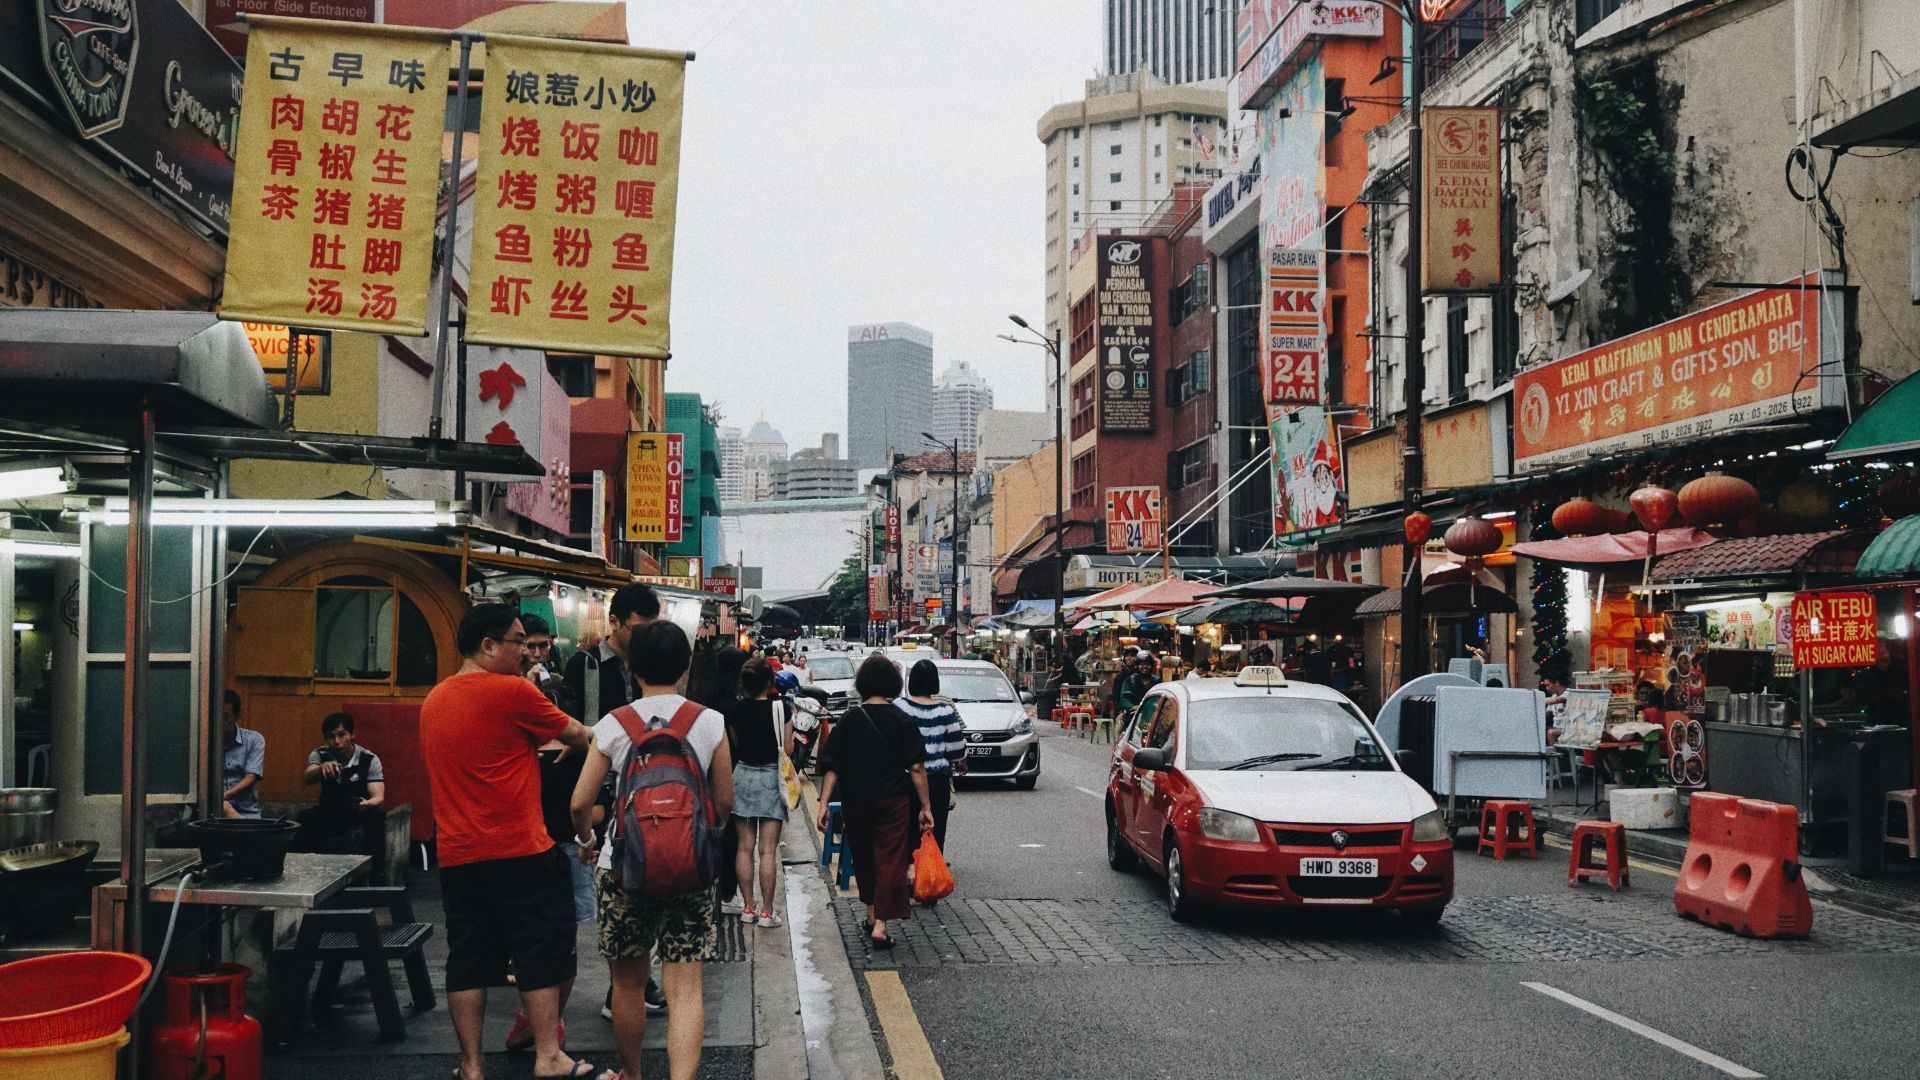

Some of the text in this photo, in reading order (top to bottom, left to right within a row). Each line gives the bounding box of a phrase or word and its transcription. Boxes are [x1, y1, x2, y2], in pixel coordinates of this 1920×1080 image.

[237, 0, 268, 11] Floor
[274, 0, 304, 13] (Side
[309, 2, 367, 18] Entrance)
[1335, 6, 1357, 18] KK
[269, 46, 427, 94] 古早味
[505, 70, 657, 114] 娘惹小炒
[261, 93, 306, 222] 肉骨茶
[1437, 159, 1448, 169] BEE
[1439, 175, 1490, 186] KEDAI
[1435, 187, 1493, 197] DAGING
[305, 98, 360, 317] 胡椒猪肚汤
[358, 103, 415, 321] 花生猪脚汤
[1440, 199, 1488, 208] SALAI
[490, 116, 541, 317] 烧烤鱼虾
[549, 119, 601, 321] 饭粥粉丝
[607, 126, 660, 326] 咖喱鱼头
[1272, 253, 1317, 266] PASAR RAYA
[1111, 265, 1140, 277] BARANG
[1106, 278, 1145, 290] PERHIASAN
[1273, 290, 1317, 312] KK
[860, 326, 889, 341] AIA
[1272, 337, 1317, 349] SUPER MART
[1561, 292, 1794, 387] KEDAI KRAFTANGAN DAN CENDERAMATA
[1274, 354, 1316, 384] 24
[1555, 320, 1808, 416] YI XIN CRAFT & GIFTS SDN. BHD.
[1275, 386, 1316, 400] JAM
[1728, 410, 1744, 424] FAX
[1751, 407, 1761, 420] 03
[1768, 401, 1788, 416] 2026
[1642, 432, 1655, 444] TEL
[1661, 427, 1669, 440] 03
[1675, 424, 1692, 437] 2026
[631, 463, 662, 473] CHINA
[633, 473, 661, 482] TOWN
[667, 441, 682, 534] HOTEL
[1114, 490, 1153, 521] KK
[889, 507, 898, 554] HOTEL
[1126, 523, 1142, 547] 24
[1144, 522, 1159, 546] JAM
[907, 539, 915, 577] Macy
[1098, 571, 1143, 583] HOTEL
[1795, 597, 1873, 620] AIR TEBU
[1795, 619, 1876, 643] 纯正甘蔗水
[1797, 644, 1876, 665] A1 SUGAR CANE
[977, 747, 993, 755] 9227
[1306, 860, 1372, 874] HWD 9368
